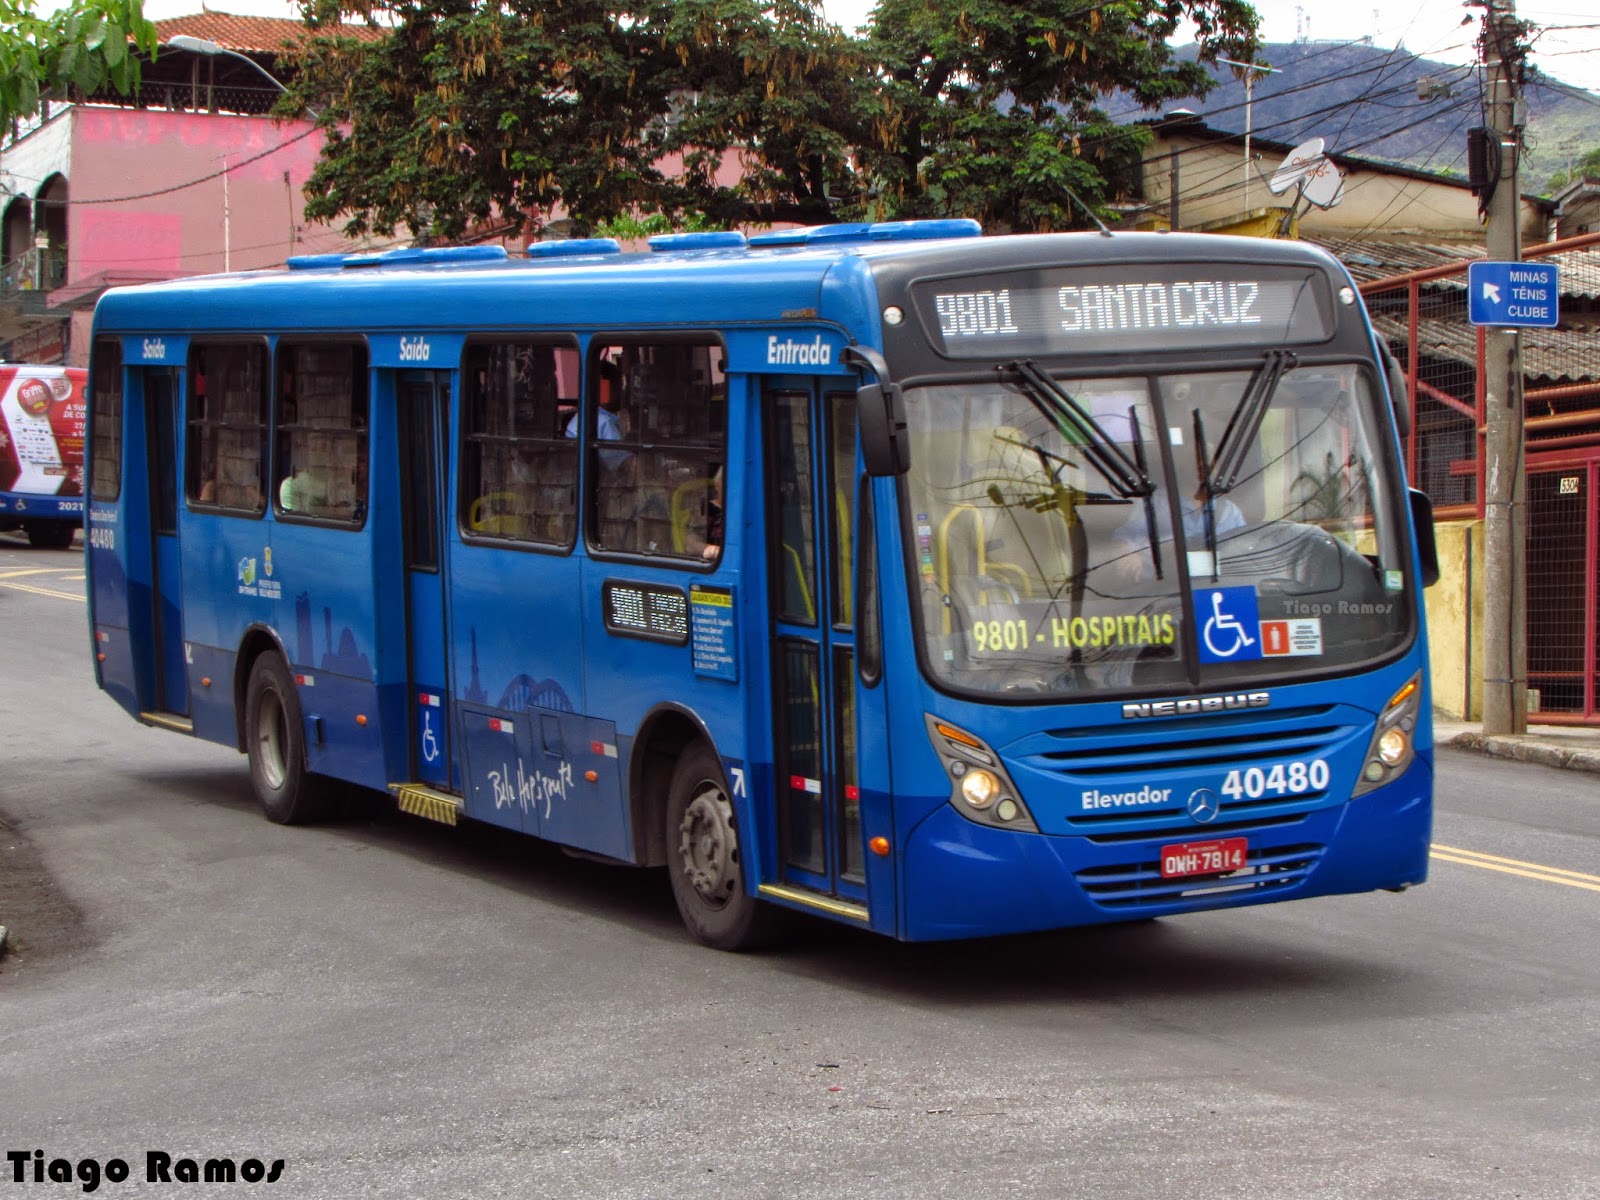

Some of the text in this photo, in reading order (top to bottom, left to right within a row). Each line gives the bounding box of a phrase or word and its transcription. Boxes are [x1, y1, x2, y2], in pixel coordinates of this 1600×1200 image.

[1509, 271, 1548, 284] MINAS
[1512, 285, 1547, 301] TÊNIS
[935, 280, 1262, 336] 9801 SANTA CRUZ
[1507, 305, 1549, 319] CLUBE
[143, 338, 165, 359] Saída
[400, 336, 430, 361] Saída
[767, 334, 831, 365] Entrada
[75, 411, 86, 419] CO
[973, 619, 1029, 652] 9801
[1051, 613, 1175, 648] HOSPITAIS
[1122, 692, 1270, 719] NEOBUS
[1081, 759, 1330, 810] Elevador 40480
[1165, 849, 1242, 874] OWH-7814
